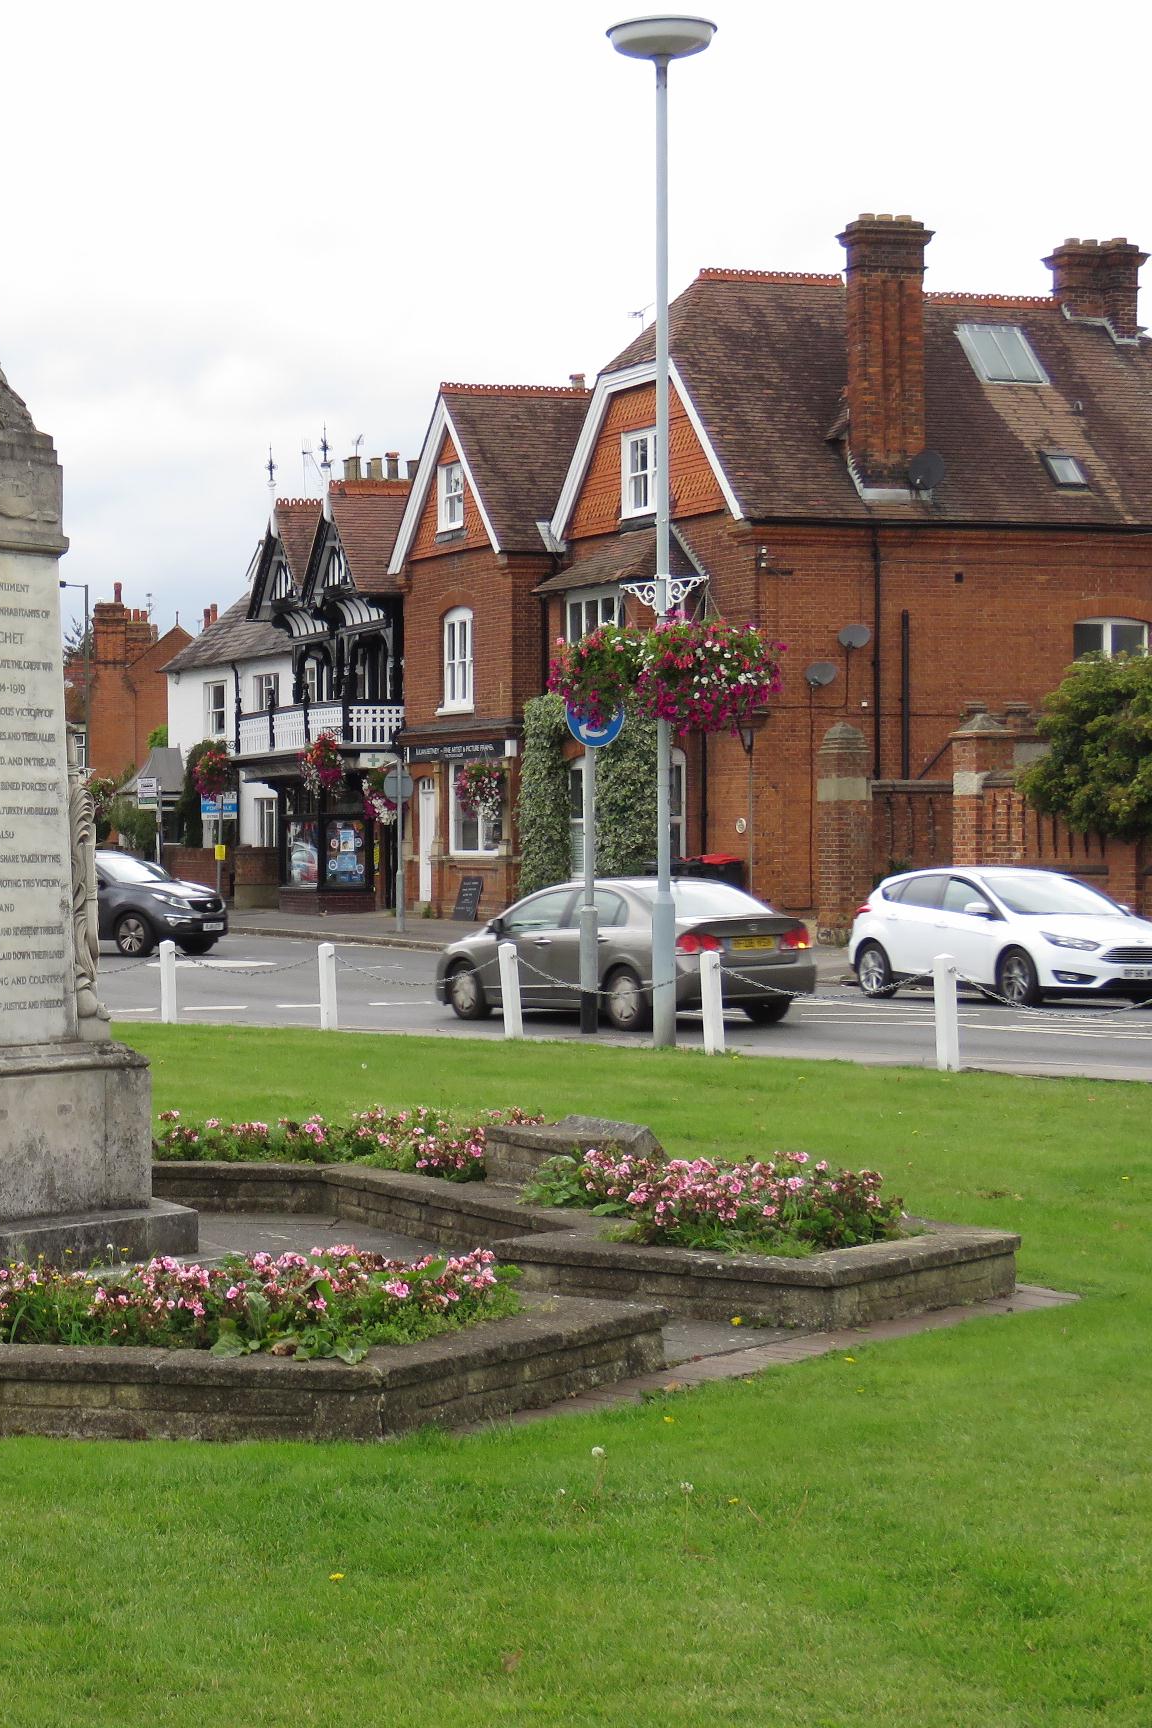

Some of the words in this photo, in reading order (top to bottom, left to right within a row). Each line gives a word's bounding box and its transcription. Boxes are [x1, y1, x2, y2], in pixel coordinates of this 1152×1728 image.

[41, 610, 50, 619] OF
[8, 732, 21, 740] AND
[8, 757, 23, 766] AND
[22, 782, 46, 791] FORCES
[0, 855, 19, 863] SHARE
[13, 951, 30, 960] DOWN
[11, 976, 26, 986] AND
[29, 975, 64, 984] COUNTRY
